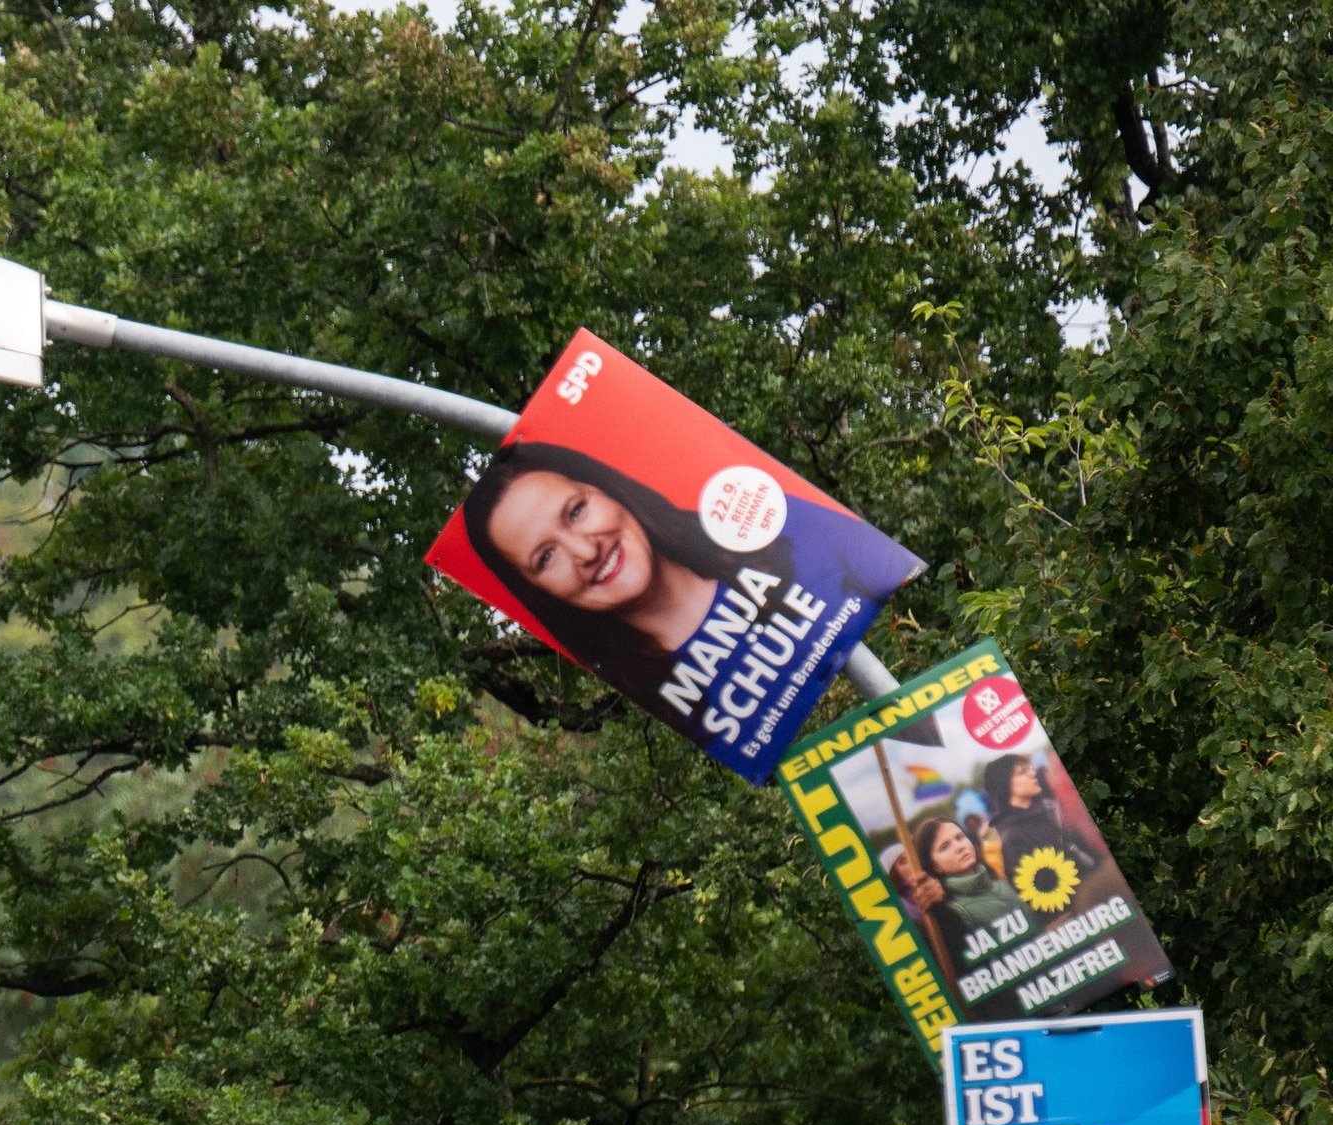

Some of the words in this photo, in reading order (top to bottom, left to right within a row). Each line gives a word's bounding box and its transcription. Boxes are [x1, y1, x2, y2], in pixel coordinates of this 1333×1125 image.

[556, 351, 603, 405] SPD
[710, 482, 742, 522] 22.9.
[731, 489, 753, 523] BEIDE
[737, 483, 769, 540] STIMMEN
[760, 508, 776, 531] SPD
[659, 567, 781, 716] MANJA
[702, 584, 827, 743] SCHÜLE
[741, 741, 761, 758] Es
[757, 707, 783, 744] geht
[778, 684, 799, 711] um
[791, 596, 861, 686] Brandenburg.
[780, 654, 1001, 782] EINANDER
[991, 711, 1030, 744] GRÜN
[789, 782, 918, 966] MUT
[958, 896, 1132, 1002] BRANDENBURG
[965, 929, 998, 960] JA
[992, 909, 1030, 943] ZU
[1017, 938, 1125, 1011] NAZIFREI
[961, 1039, 1023, 1082] ES
